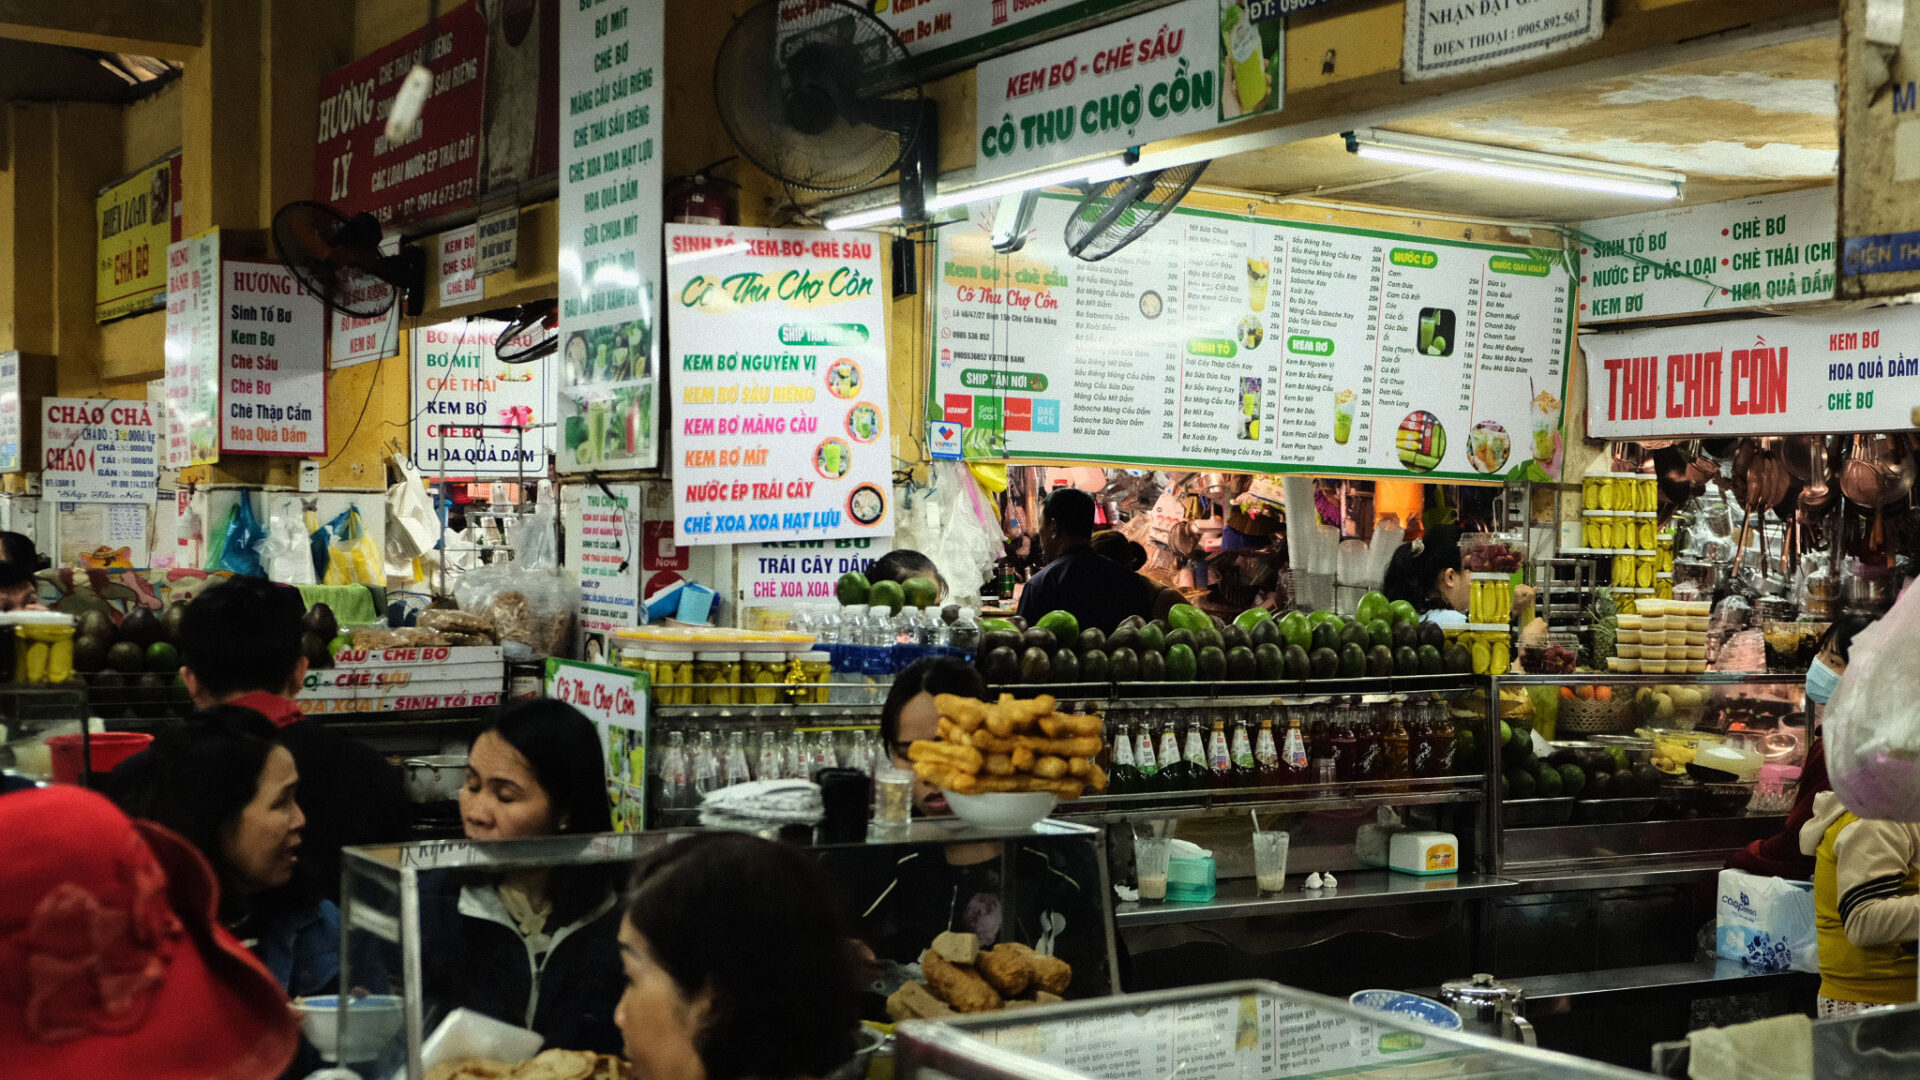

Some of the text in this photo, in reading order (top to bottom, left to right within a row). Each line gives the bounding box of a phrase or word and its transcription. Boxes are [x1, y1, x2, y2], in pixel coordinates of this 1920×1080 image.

[595, 13, 608, 39] BƠ
[1433, 39, 1465, 56] ĐIỆN
[1469, 30, 1508, 48] THOẠI
[1517, 9, 1580, 36] 0905.892.563
[1006, 68, 1046, 99] KEM
[1050, 57, 1077, 88] BƠ
[1092, 38, 1134, 75] CHÈ
[318, 78, 375, 144] HƯƠNG
[981, 57, 1215, 158] CÔ THU CHỢ CỒN
[330, 140, 354, 202] LÝ
[1732, 215, 1787, 241] CHÈ BƠ
[445, 236, 462, 254] KEM
[673, 235, 712, 253] SINH
[746, 239, 780, 257] KEM
[1593, 229, 1668, 259] SINH TỐ BƠ
[1593, 255, 1717, 287] NƯỚC ÉP CÁC LOẠI
[234, 271, 291, 295] HƯƠNG
[721, 271, 770, 303] Thu
[777, 268, 824, 303] Chợ
[828, 266, 874, 297] Cồn
[956, 284, 1059, 311] Cô Thu Chợ Cồn
[1592, 293, 1644, 316] KEM BƠ
[232, 305, 292, 323] Sinh Tố Bơ
[231, 330, 275, 346] Kem Bơ
[1829, 329, 1880, 352] KEM BƠ
[427, 352, 480, 368] BƠ MÍT
[683, 351, 816, 375] KEM BƠ NGUYÊN VỊ
[1829, 363, 1852, 382] HOA
[1858, 355, 1884, 379] QUẢ
[231, 379, 271, 395] Chè Bơ
[427, 373, 497, 392] CHÈ THÁI
[966, 371, 988, 386] SHIP
[1604, 335, 1789, 425] THU CHỢ CỒN
[684, 386, 715, 404] KEM
[718, 384, 739, 403] BƠ
[773, 383, 816, 403] RIÊNG
[1828, 389, 1874, 411] CHÈ BƠ
[48, 401, 152, 426] CHÁO CHẢ
[231, 403, 253, 419] Chè
[257, 404, 283, 424] Thập
[427, 400, 487, 415] KEM BƠ
[231, 426, 253, 441] Hoa
[257, 425, 278, 443] Quả
[684, 410, 818, 435] KEM BƠ MÃNG CẦU
[465, 445, 497, 465] QUẢ
[685, 445, 769, 467] KEM BƠ MÍT
[686, 478, 815, 502] NƯỚC ÉP TRÁI CÂY
[684, 508, 841, 535] CHÈ XOA XOA HẠT LỰU
[656, 558, 678, 567] Now
[758, 554, 795, 574] TRÁI
[801, 554, 833, 574] CÂY
[754, 579, 830, 598] CHÈ XOA XOA
[394, 696, 439, 711] SINH
[573, 679, 591, 706] Thu
[594, 683, 613, 718] Chợ
[616, 686, 635, 716] Cồn
